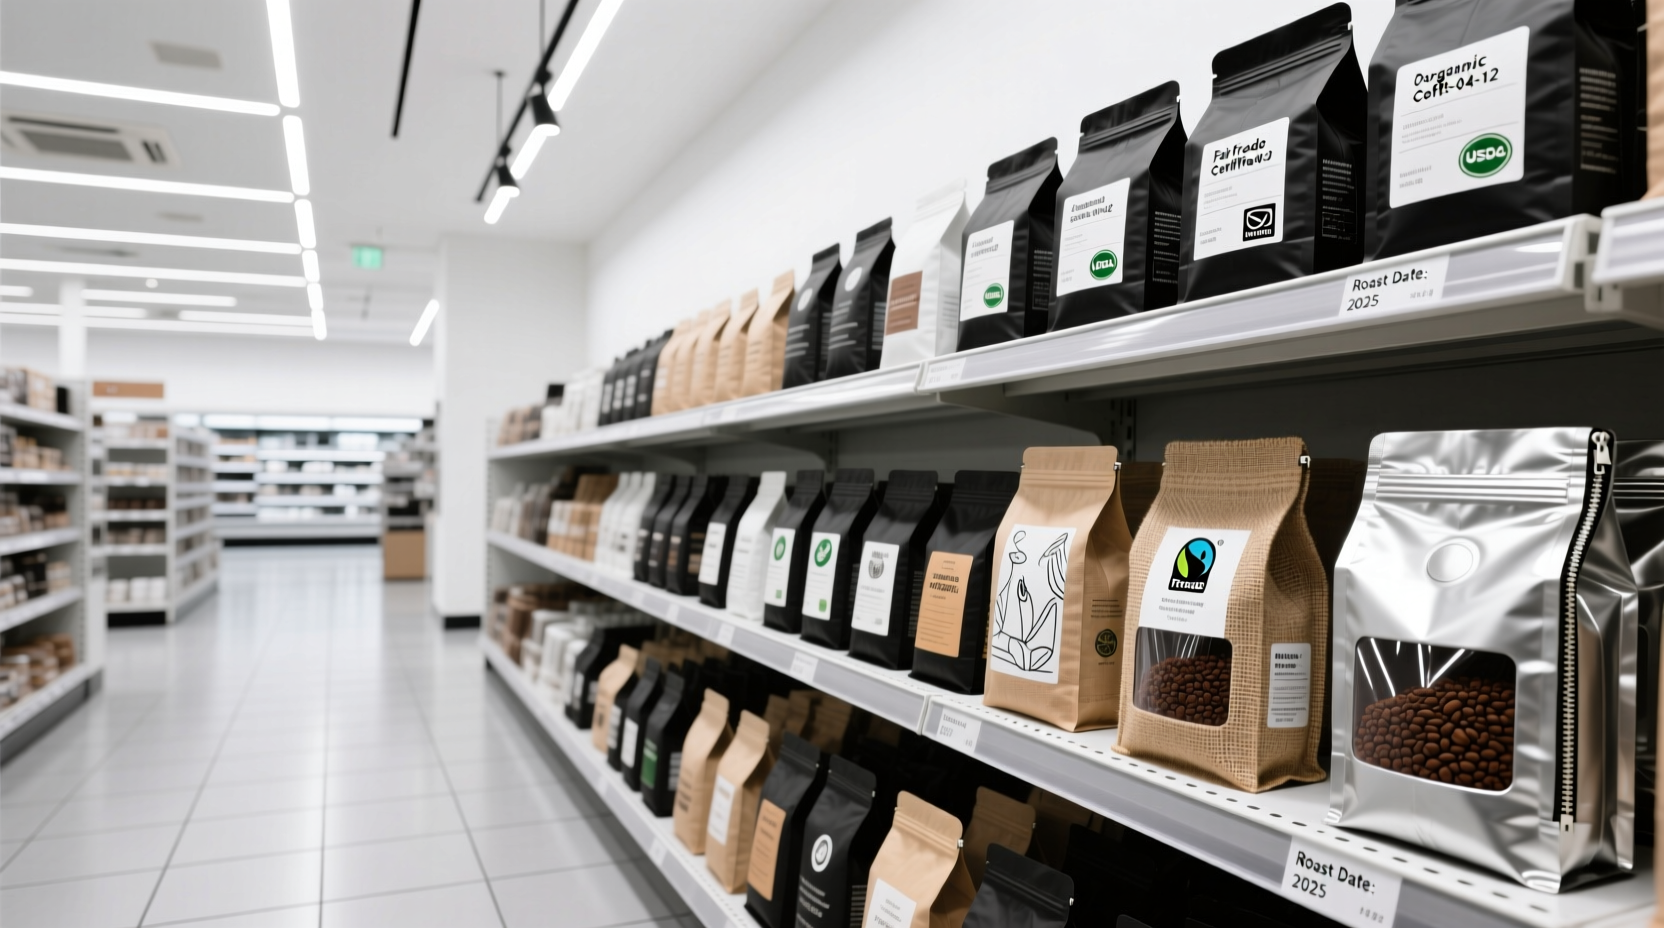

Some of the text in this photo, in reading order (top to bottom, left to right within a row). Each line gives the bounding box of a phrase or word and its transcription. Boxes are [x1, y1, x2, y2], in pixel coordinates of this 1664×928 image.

[1352, 268, 1428, 292] Roast Date:
[1347, 294, 1379, 312] 2025
[1296, 850, 1376, 895] Roast Date:
[1291, 873, 1327, 899] 2025
